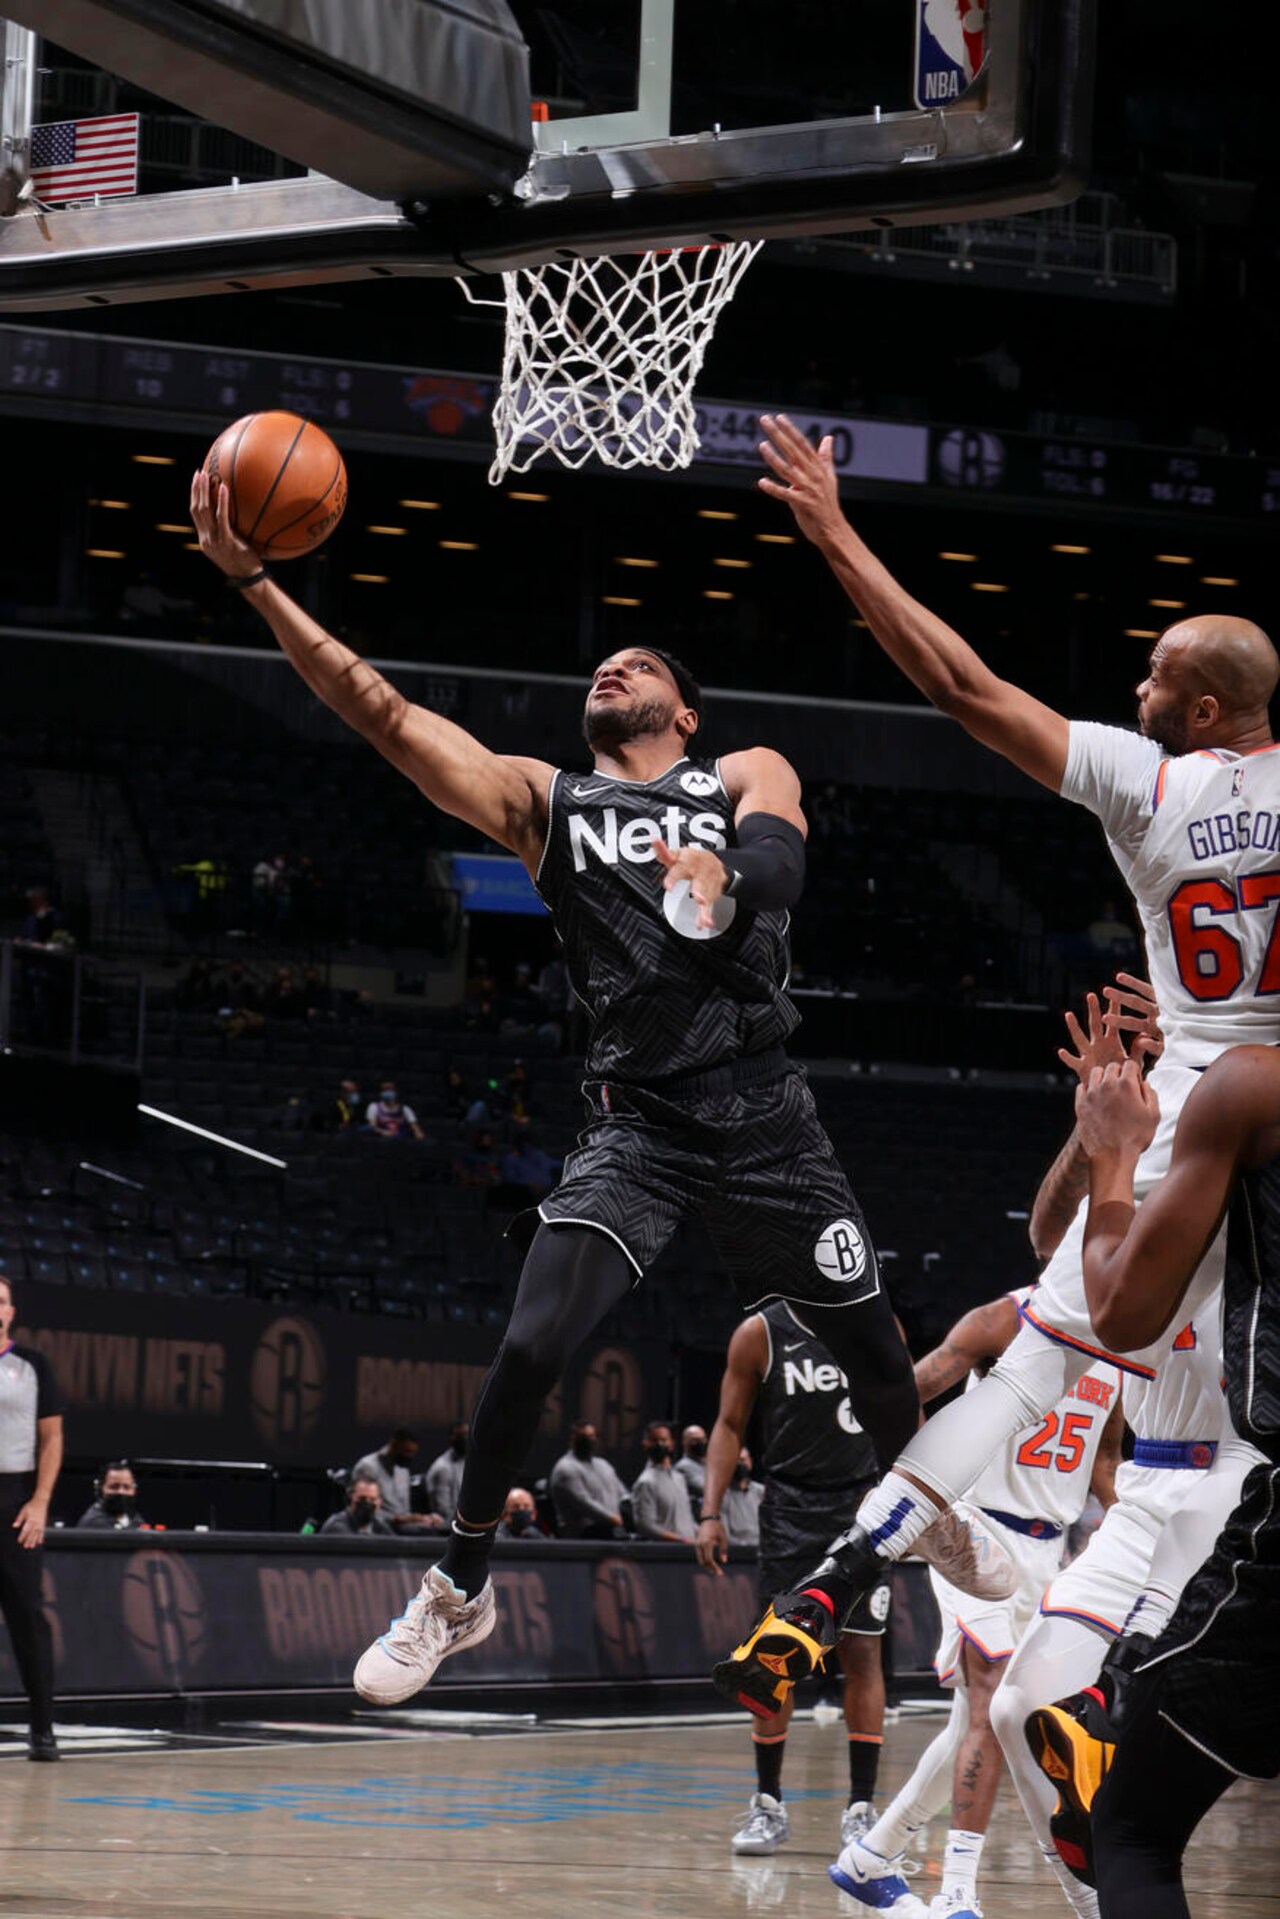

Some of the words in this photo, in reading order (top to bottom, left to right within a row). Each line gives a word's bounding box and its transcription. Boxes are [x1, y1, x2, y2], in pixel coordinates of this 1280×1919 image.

[925, 70, 959, 100] NBA
[568, 806, 728, 873] Nets
[1168, 870, 1280, 1002] 67
[1066, 1376, 1115, 1411] ORK
[1016, 1410, 1093, 1473] 25
